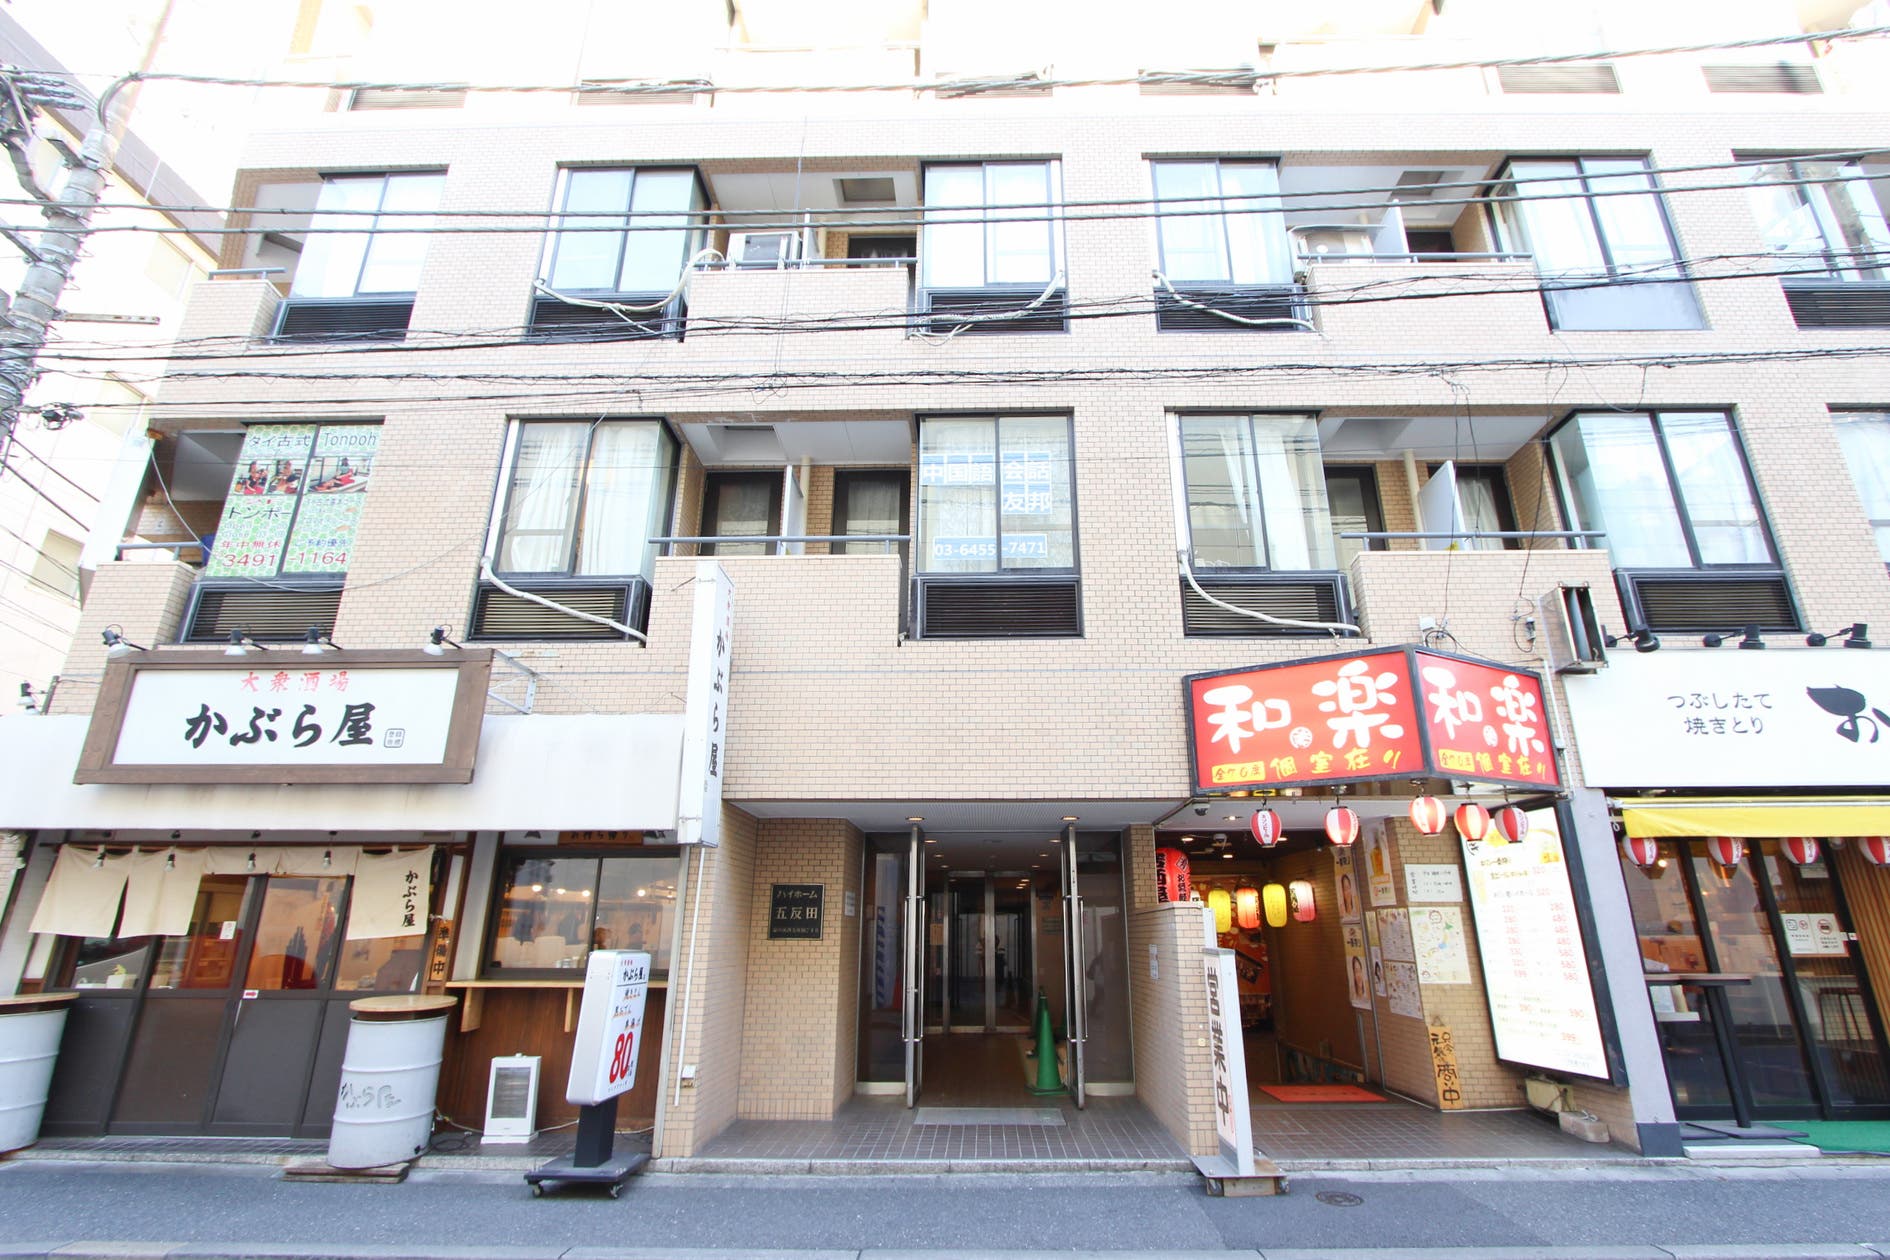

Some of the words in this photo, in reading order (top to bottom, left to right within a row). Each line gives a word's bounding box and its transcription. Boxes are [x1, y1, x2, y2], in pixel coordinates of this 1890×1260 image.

[250, 434, 311, 448] タイ古式
[323, 432, 377, 449] Tonpoh
[923, 463, 993, 483] 中国語
[1004, 461, 1050, 481] 会話
[1003, 492, 1051, 512] 友邦
[221, 540, 281, 549] 年中無休
[935, 543, 996, 557] 03-6455
[222, 554, 276, 567] 3491
[240, 670, 350, 693] 大衆酒場
[1666, 692, 1774, 710] つぶしたて
[184, 702, 376, 750] かぶら屋
[1683, 716, 1765, 735] 焼きとり
[401, 869, 418, 928] かぶら屋
[776, 890, 818, 900] ハイホーム
[775, 906, 819, 921] 五反田
[1207, 966, 1230, 1127] 営業中
[608, 1032, 634, 1084] 80
